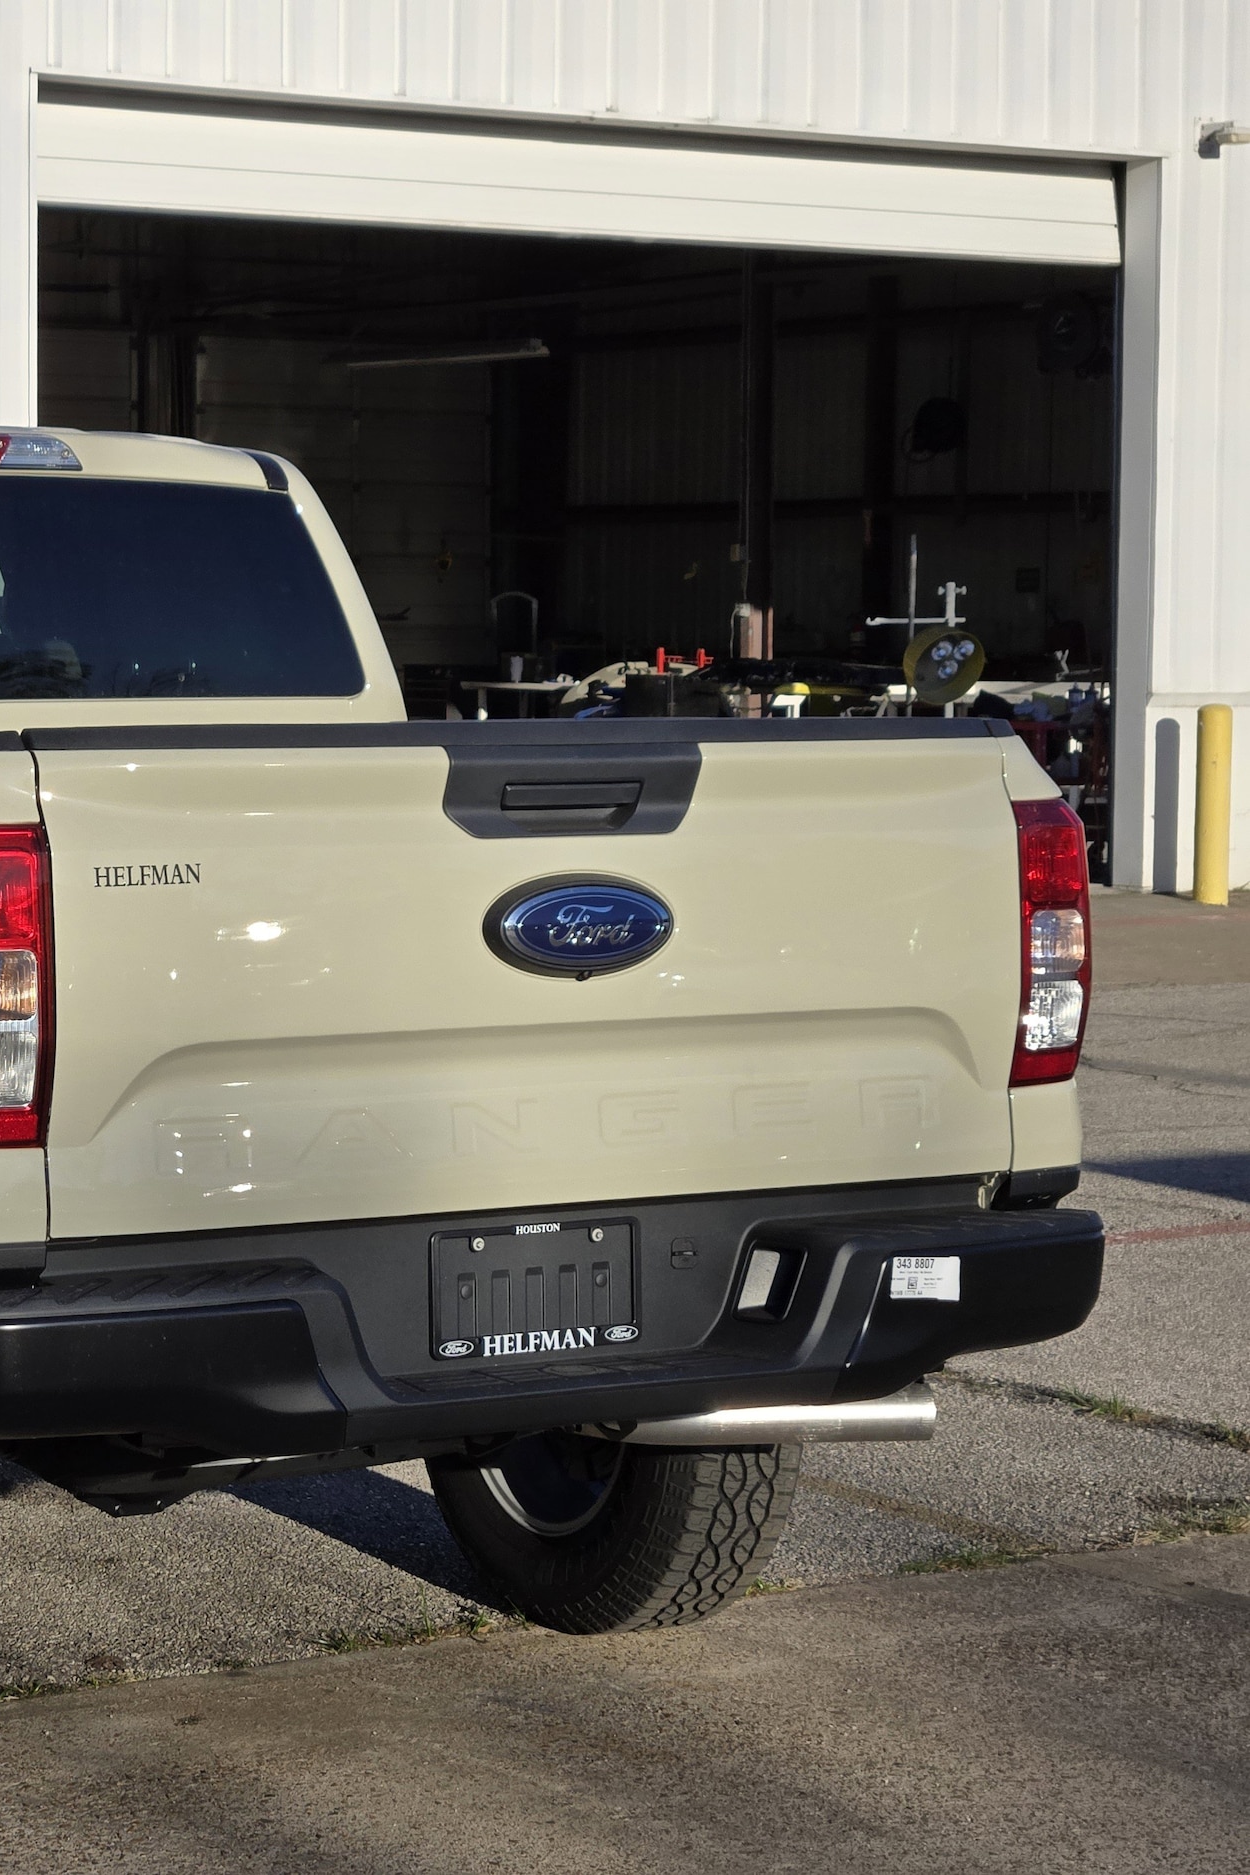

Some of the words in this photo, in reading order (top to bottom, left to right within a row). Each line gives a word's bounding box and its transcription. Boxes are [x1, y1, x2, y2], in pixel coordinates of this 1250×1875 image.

[93, 863, 201, 888] HELFMAN
[548, 903, 636, 947] Ford
[153, 1074, 940, 1177] RANGER
[515, 1222, 561, 1236] HOUSTON
[896, 1258, 912, 1269] 343
[914, 1258, 935, 1269] 8807
[444, 1341, 469, 1355] Ford
[482, 1326, 597, 1357] HELFMAN
